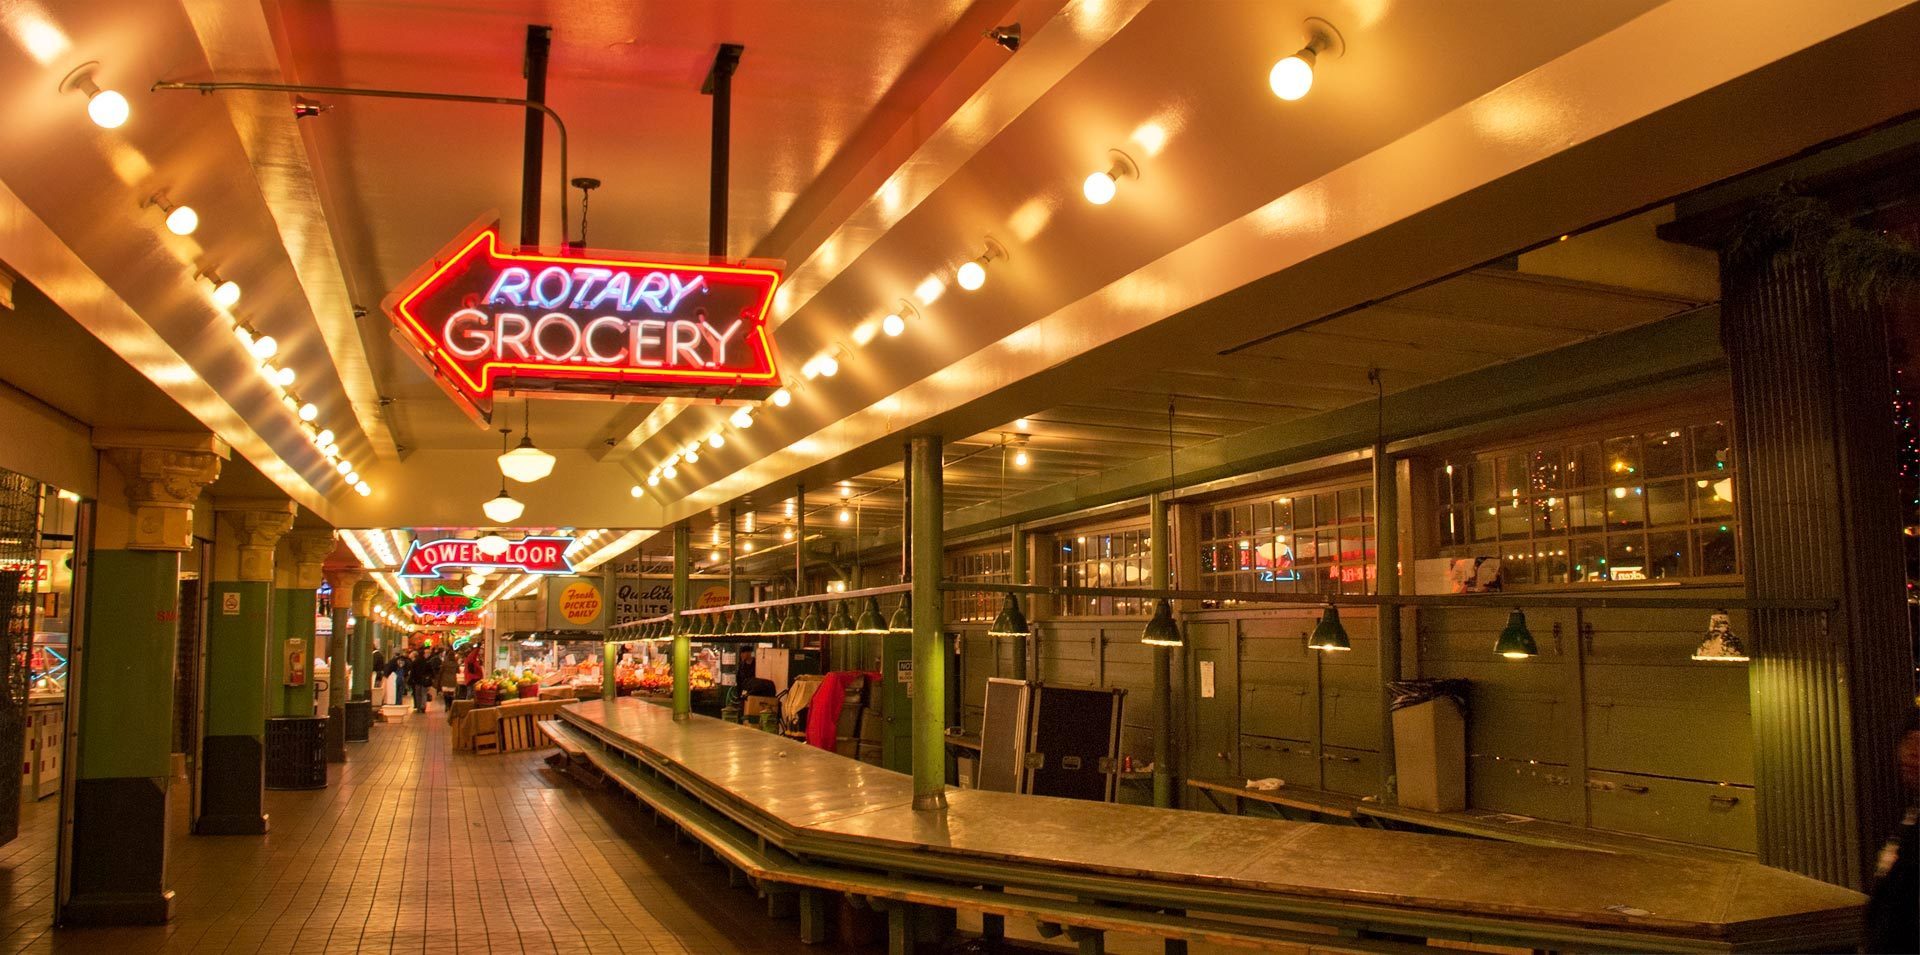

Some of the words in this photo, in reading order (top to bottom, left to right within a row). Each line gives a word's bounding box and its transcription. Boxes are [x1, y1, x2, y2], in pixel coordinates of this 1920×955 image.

[486, 266, 704, 313] ROTARY
[443, 308, 742, 367] GROCERY
[413, 544, 482, 571] LOWER
[568, 588, 594, 600] Fresh
[618, 585, 673, 603] Quality
[564, 600, 598, 609] PICKED
[568, 610, 593, 618] DAILY
